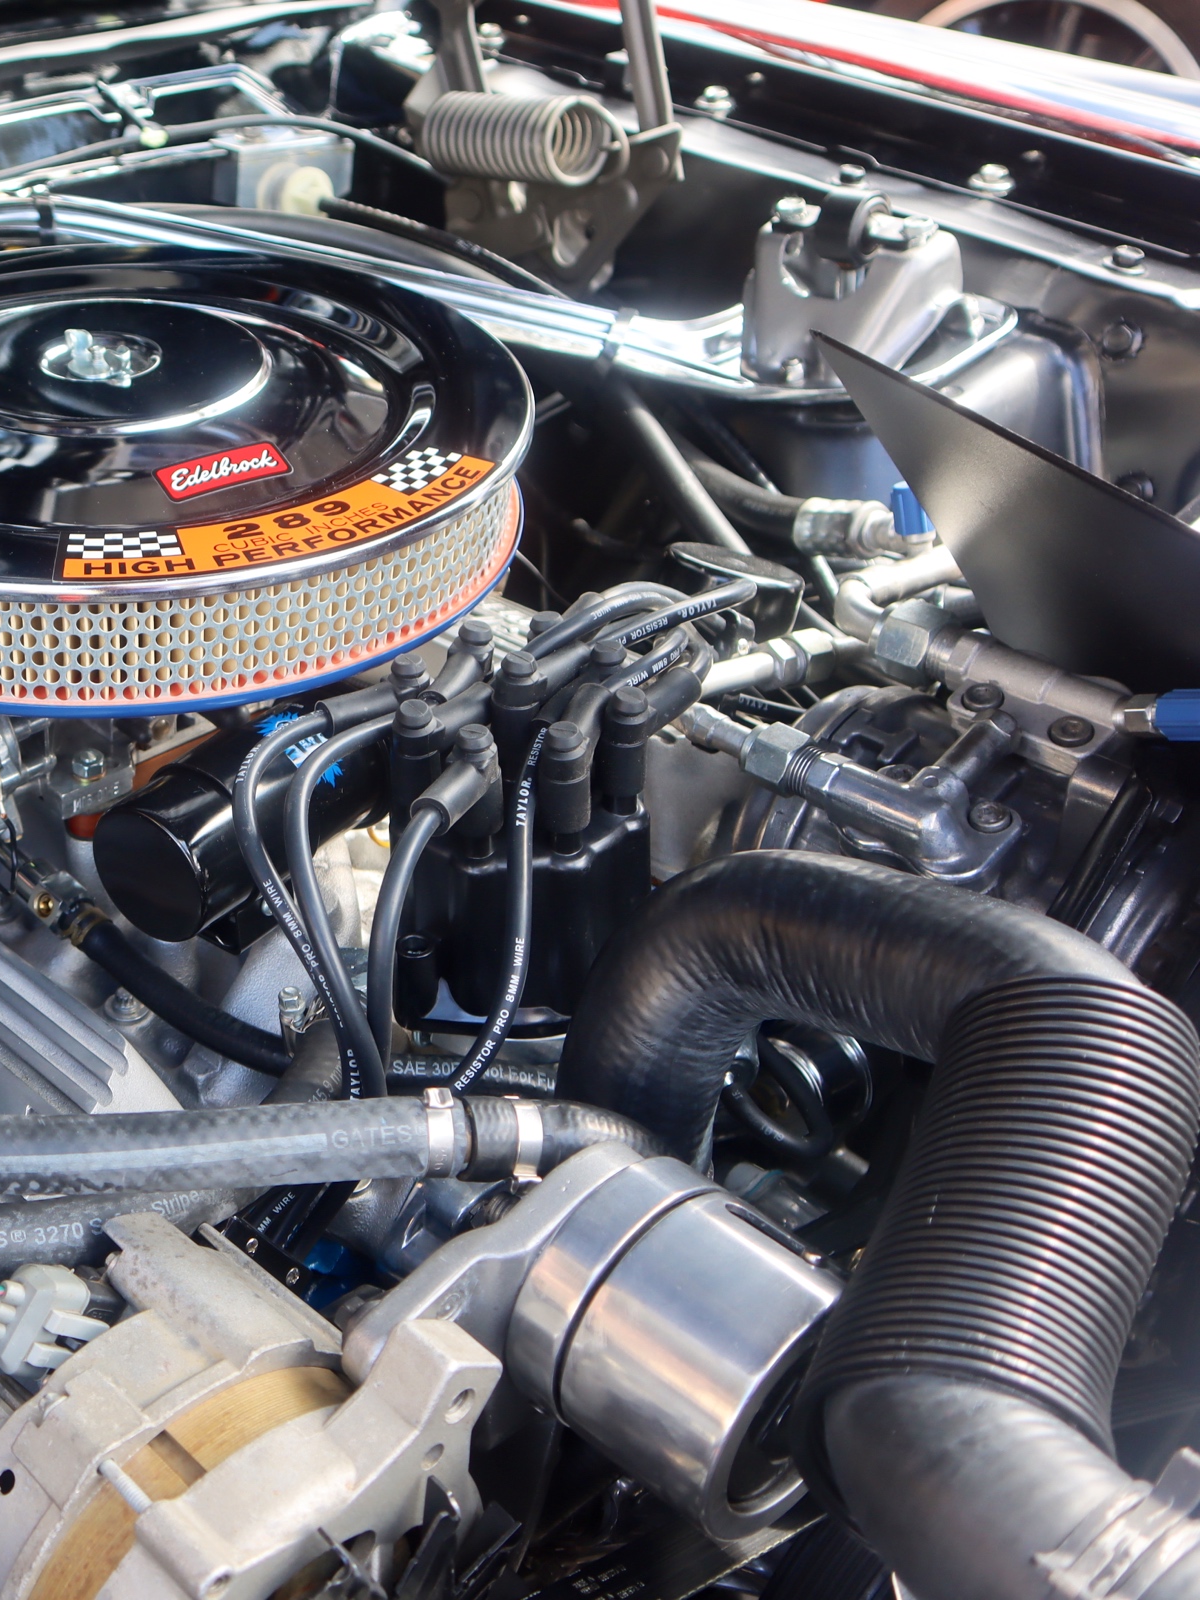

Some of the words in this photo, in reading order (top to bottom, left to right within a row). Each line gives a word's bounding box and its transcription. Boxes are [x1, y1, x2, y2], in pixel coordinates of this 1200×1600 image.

[169, 449, 277, 489] Edelbrock
[83, 558, 196, 575] HIGH
[212, 465, 482, 567] PERFORMANCE
[213, 532, 294, 553] CUBIC
[305, 502, 390, 535] INCHES
[222, 500, 352, 540] 289
[630, 616, 669, 640] RESISTOR
[627, 669, 649, 687] WIRE
[651, 658, 668, 673] 8MM
[737, 693, 769, 711] TAYLO
[527, 727, 548, 767] RESISTOR
[262, 878, 283, 909] WIRE
[282, 911, 304, 939] 8MM
[301, 943, 320, 970] PRO
[513, 936, 525, 968] WIRE
[505, 973, 522, 1004] 8MM
[493, 1008, 510, 1036] PRO
[392, 1060, 427, 1076] SAE
[454, 1039, 497, 1092] RESISTOR
[508, 1066, 534, 1082] For
[537, 1071, 555, 1091] Fu
[257, 1216, 272, 1233] MM
[272, 1191, 296, 1214] WIRE
[33, 1221, 84, 1245] 3270
